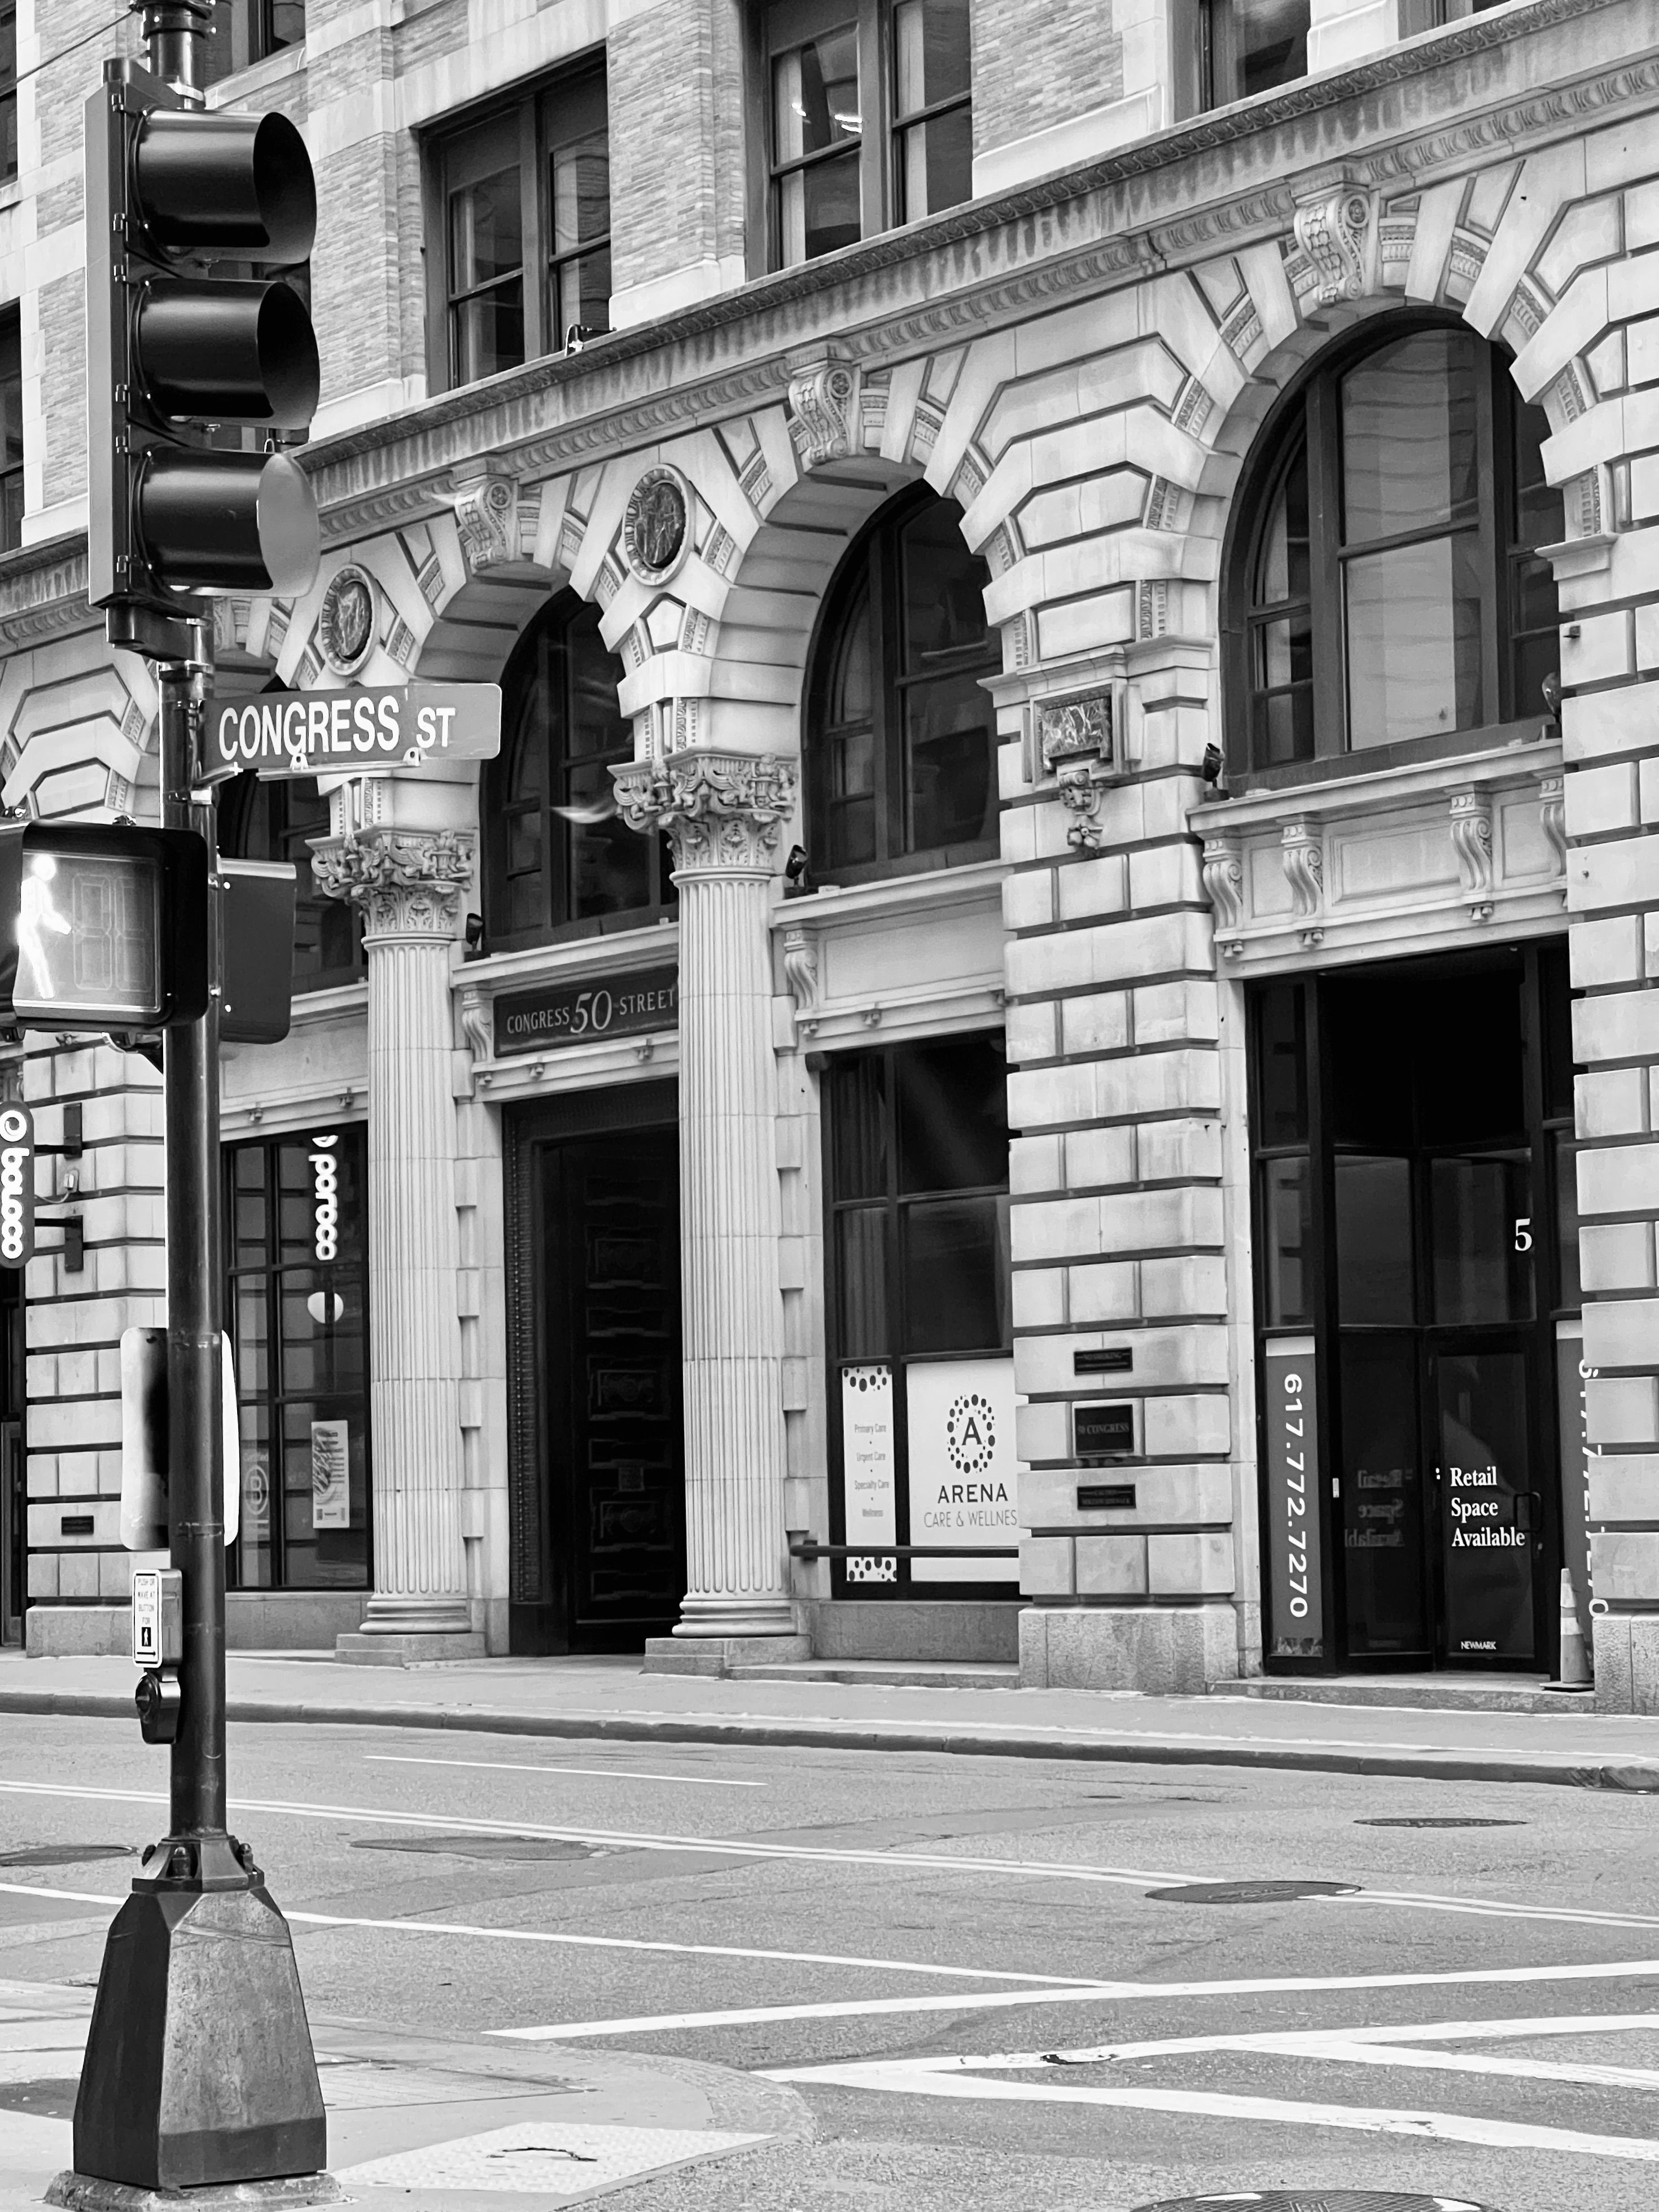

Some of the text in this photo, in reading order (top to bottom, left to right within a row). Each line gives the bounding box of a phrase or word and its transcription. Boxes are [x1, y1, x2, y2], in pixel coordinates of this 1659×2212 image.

[220, 695, 456, 760] CONGRESS ST
[507, 989, 674, 1033] CONGRESS 50 STREET
[1514, 1219, 1533, 1251] 5
[875, 1423, 887, 1433] Care
[962, 1417, 982, 1446] A
[874, 1451, 886, 1461] Care
[878, 1479, 890, 1489] Care
[1450, 1466, 1498, 1487] Retail
[938, 1483, 1008, 1504] ARENA
[1284, 1374, 1308, 1618] 617.772.7270
[924, 1509, 1017, 1528] CARE & WELLNES
[1451, 1497, 1498, 1523] Space
[1451, 1526, 1525, 1547] Available
[1461, 1641, 1496, 1650] NEWMARK
